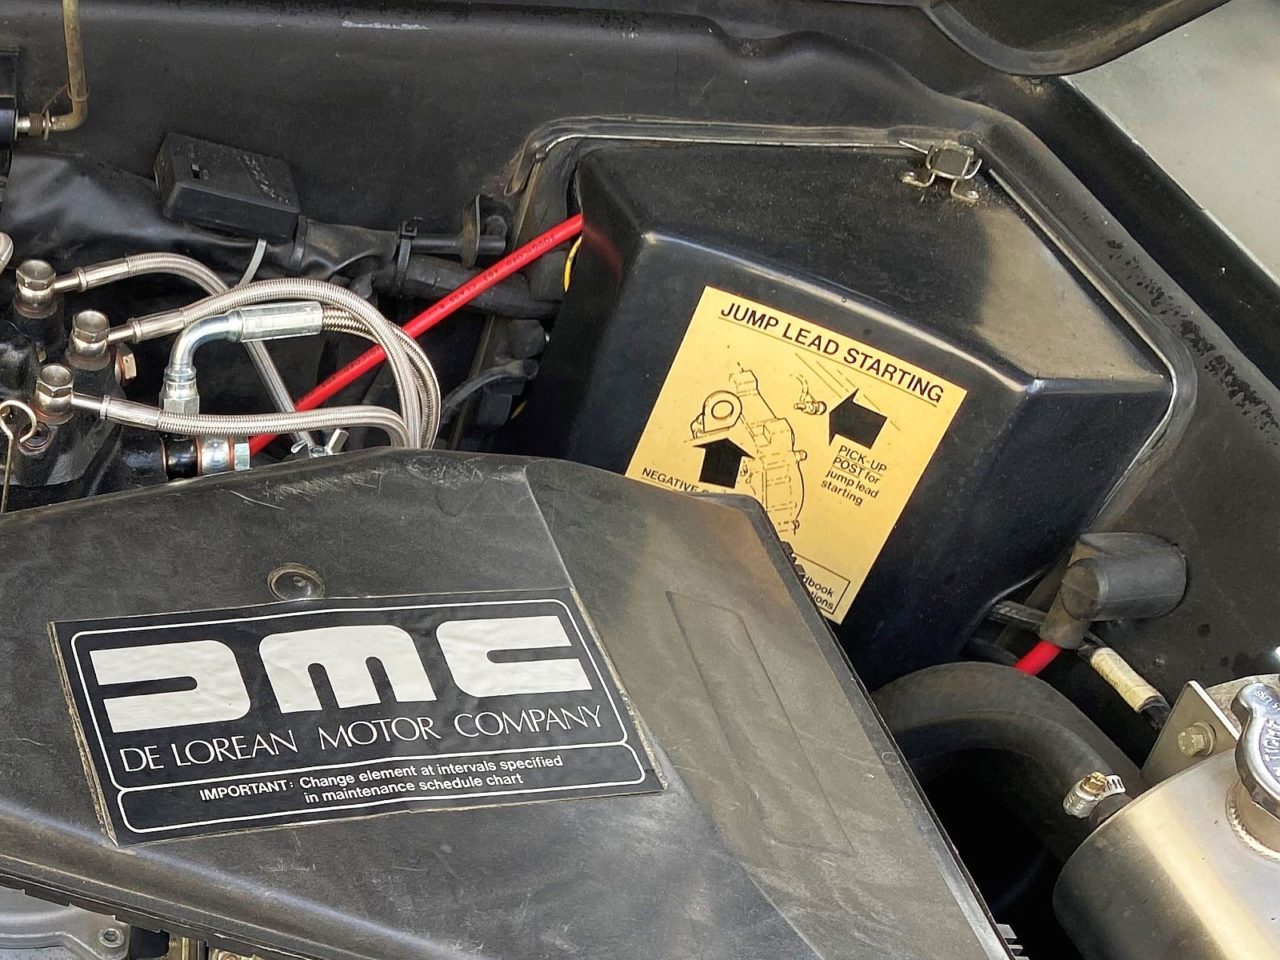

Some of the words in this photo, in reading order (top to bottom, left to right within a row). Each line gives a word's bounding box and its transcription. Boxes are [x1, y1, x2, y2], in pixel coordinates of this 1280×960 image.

[720, 302, 779, 332] JUMP
[782, 322, 839, 356] LEAD
[843, 348, 945, 404] STARTING
[832, 456, 863, 476] POST
[864, 469, 881, 485] for
[838, 444, 888, 472] PICK-UP
[641, 467, 700, 492] NEGATIVE
[821, 479, 864, 507] starting
[825, 469, 854, 493] jump
[855, 478, 880, 499] lead
[119, 745, 164, 773] DE
[173, 730, 299, 768] LOREAN
[319, 718, 440, 753] MOTOR
[454, 704, 604, 739] COMPANY
[199, 780, 295, 801] IMPORTANT:
[298, 771, 356, 792] Change
[358, 764, 417, 784] element
[420, 765, 433, 778] at
[436, 757, 497, 776] intervals
[499, 753, 564, 774] specified
[304, 791, 319, 803] in
[321, 780, 417, 802] maintenance
[418, 775, 483, 793] schedule
[486, 772, 524, 787] chart
